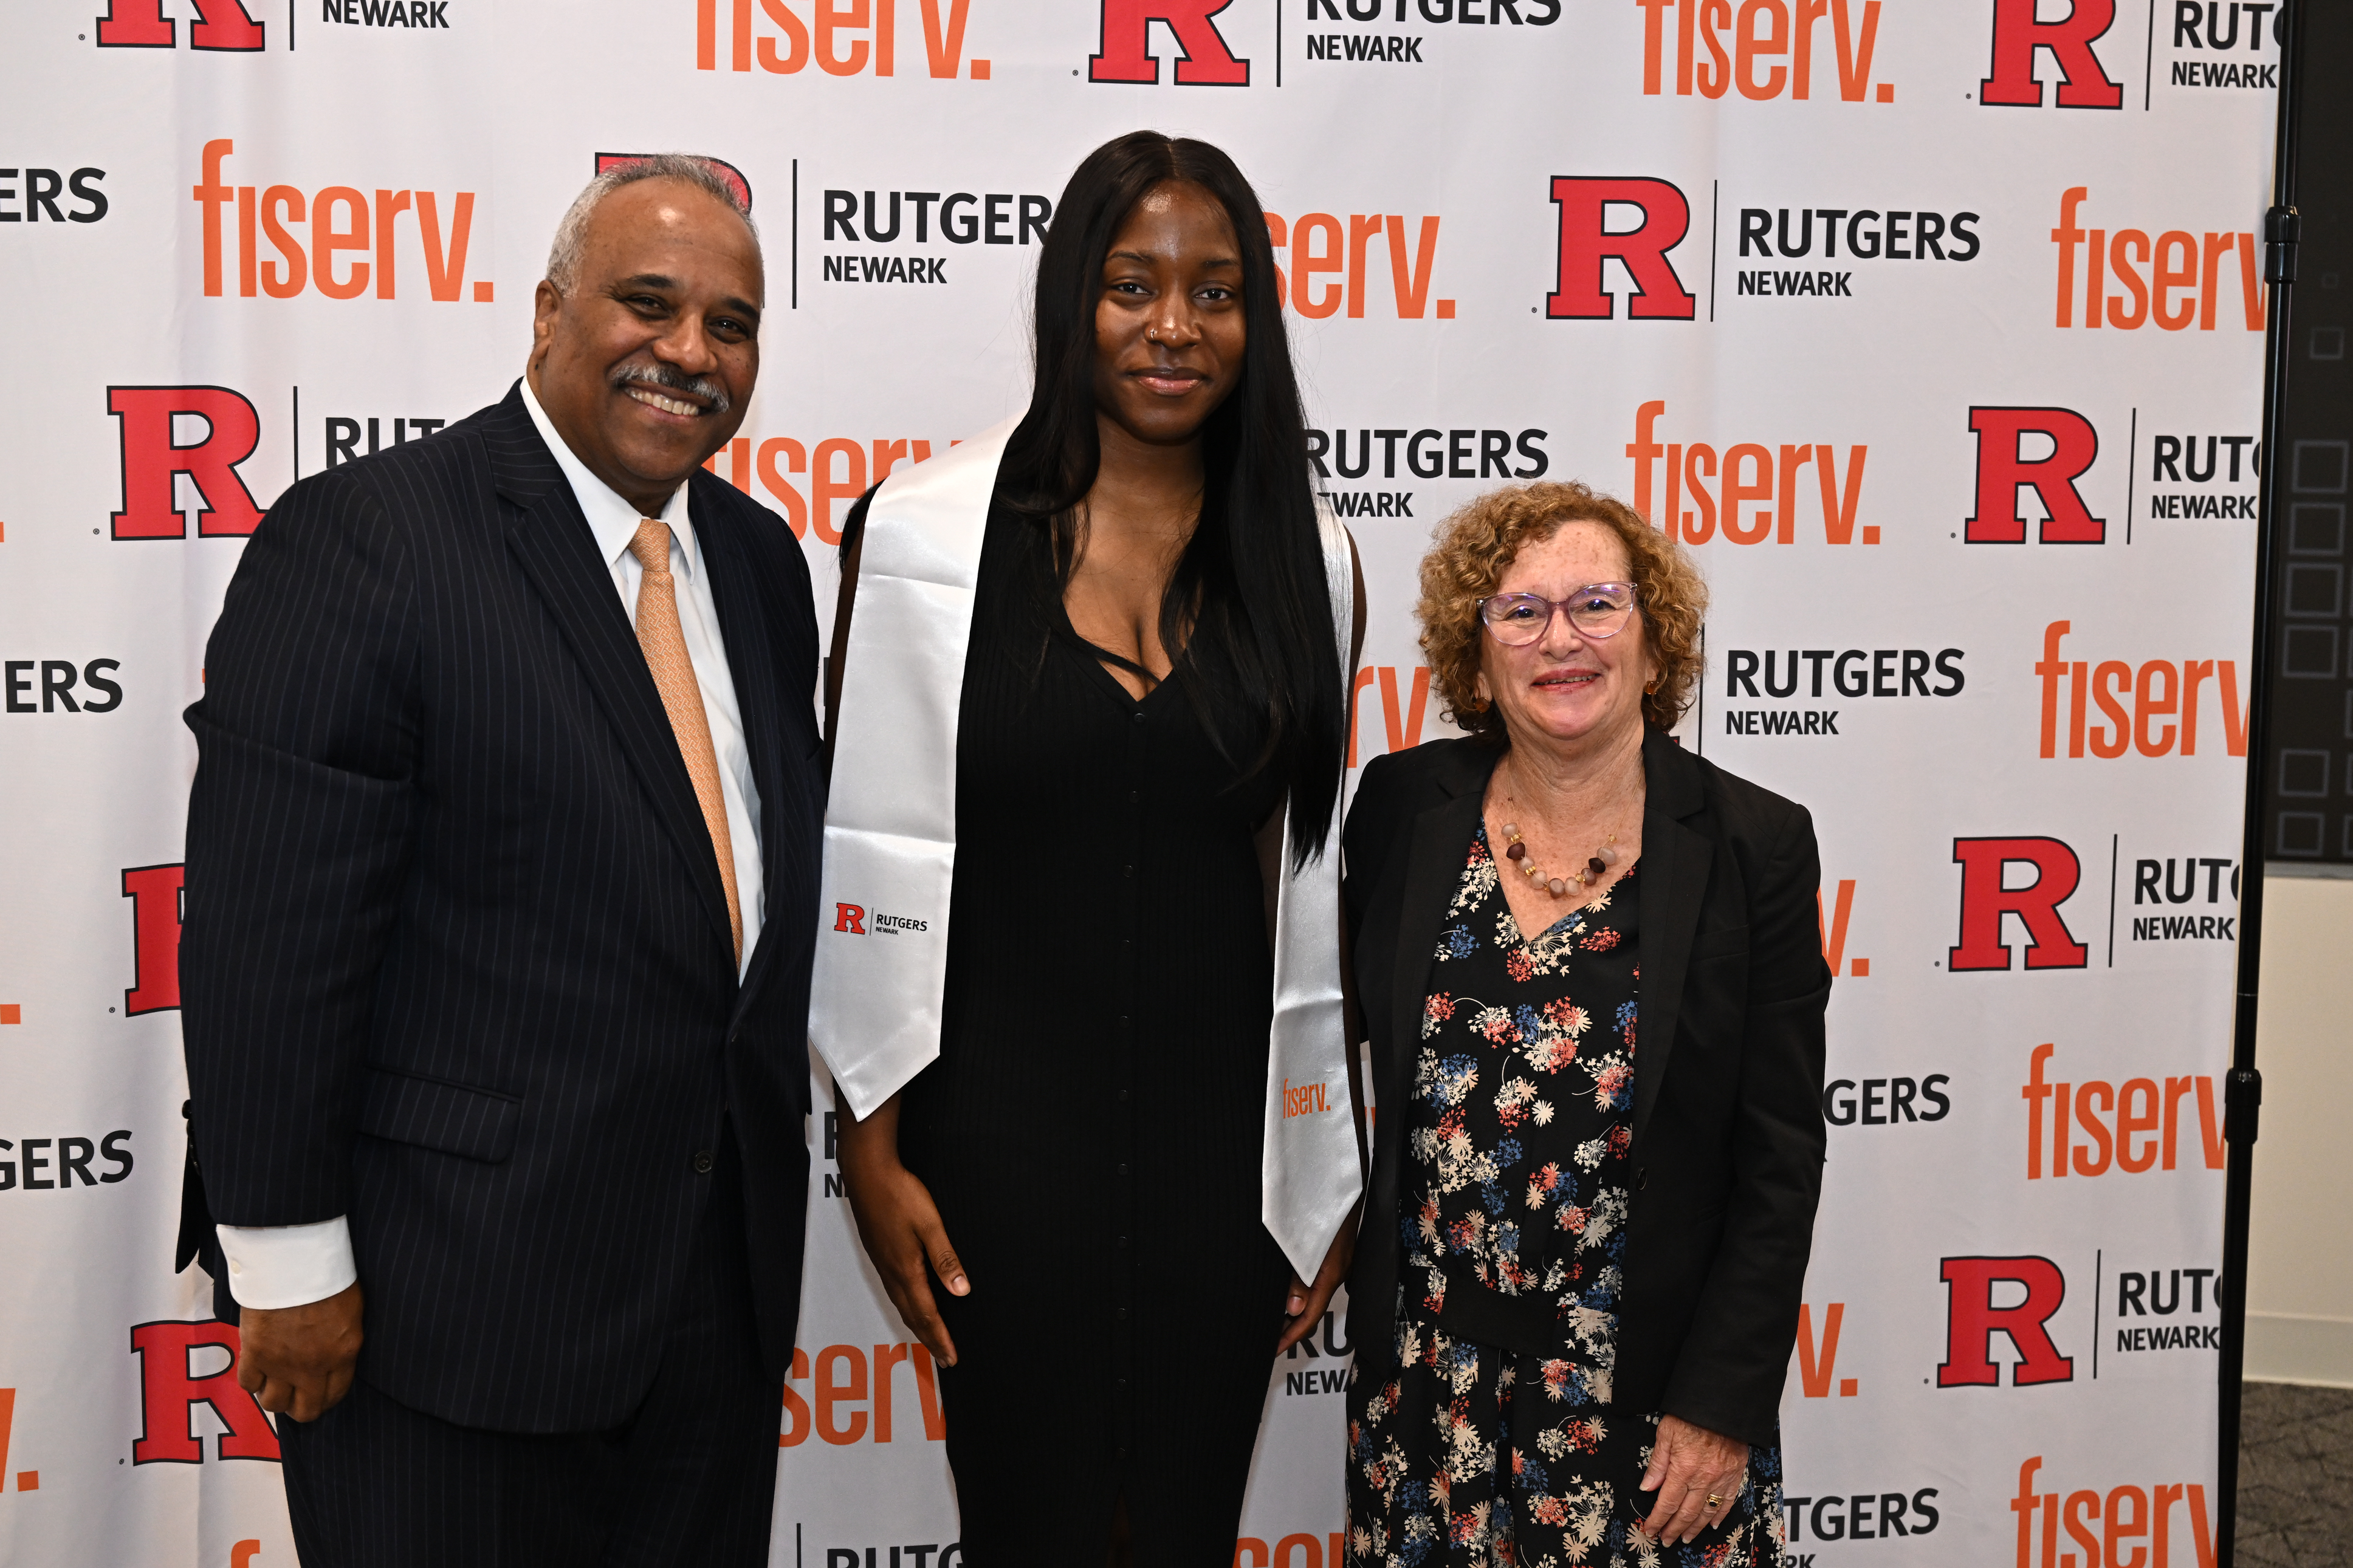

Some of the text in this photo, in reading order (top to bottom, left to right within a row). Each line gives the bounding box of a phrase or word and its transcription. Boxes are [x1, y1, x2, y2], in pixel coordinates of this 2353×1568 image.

[323, 0, 448, 28] NEWARK
[2174, 1, 2283, 51] RUT
[1308, 35, 1423, 62] NEWARK
[2172, 61, 2277, 88] NEWARK
[1546, 176, 1695, 321] R
[1740, 208, 1980, 261] RUTGERS
[824, 256, 946, 284] NEWARK
[1739, 271, 1852, 296] NEWARK
[107, 385, 267, 541] R
[1305, 429, 1548, 479] RUTGERS
[1965, 406, 2106, 544] R
[2153, 436, 2260, 482] RUT
[1317, 491, 1414, 518] WARK
[2152, 495, 2256, 519] NEWARK
[5, 659, 123, 713] ERS
[1728, 649, 1965, 697] RUTGERS
[1726, 711, 1839, 735] NEWARK
[1949, 836, 2088, 972] R
[2135, 858, 2239, 905] RUT
[834, 902, 865, 935] R
[876, 914, 928, 931] RUTGERS
[876, 926, 899, 935] NEWARK
[2133, 916, 2235, 941] NEWARK
[1823, 1074, 1950, 1126] GERS
[2119, 1268, 2221, 1316] RUT
[1937, 1255, 2073, 1389] R
[2117, 1326, 2219, 1352] NEWARK
[131, 1319, 283, 1467] R
[1286, 1369, 1347, 1395] NEW
[1784, 1488, 1939, 1541] TGERS
